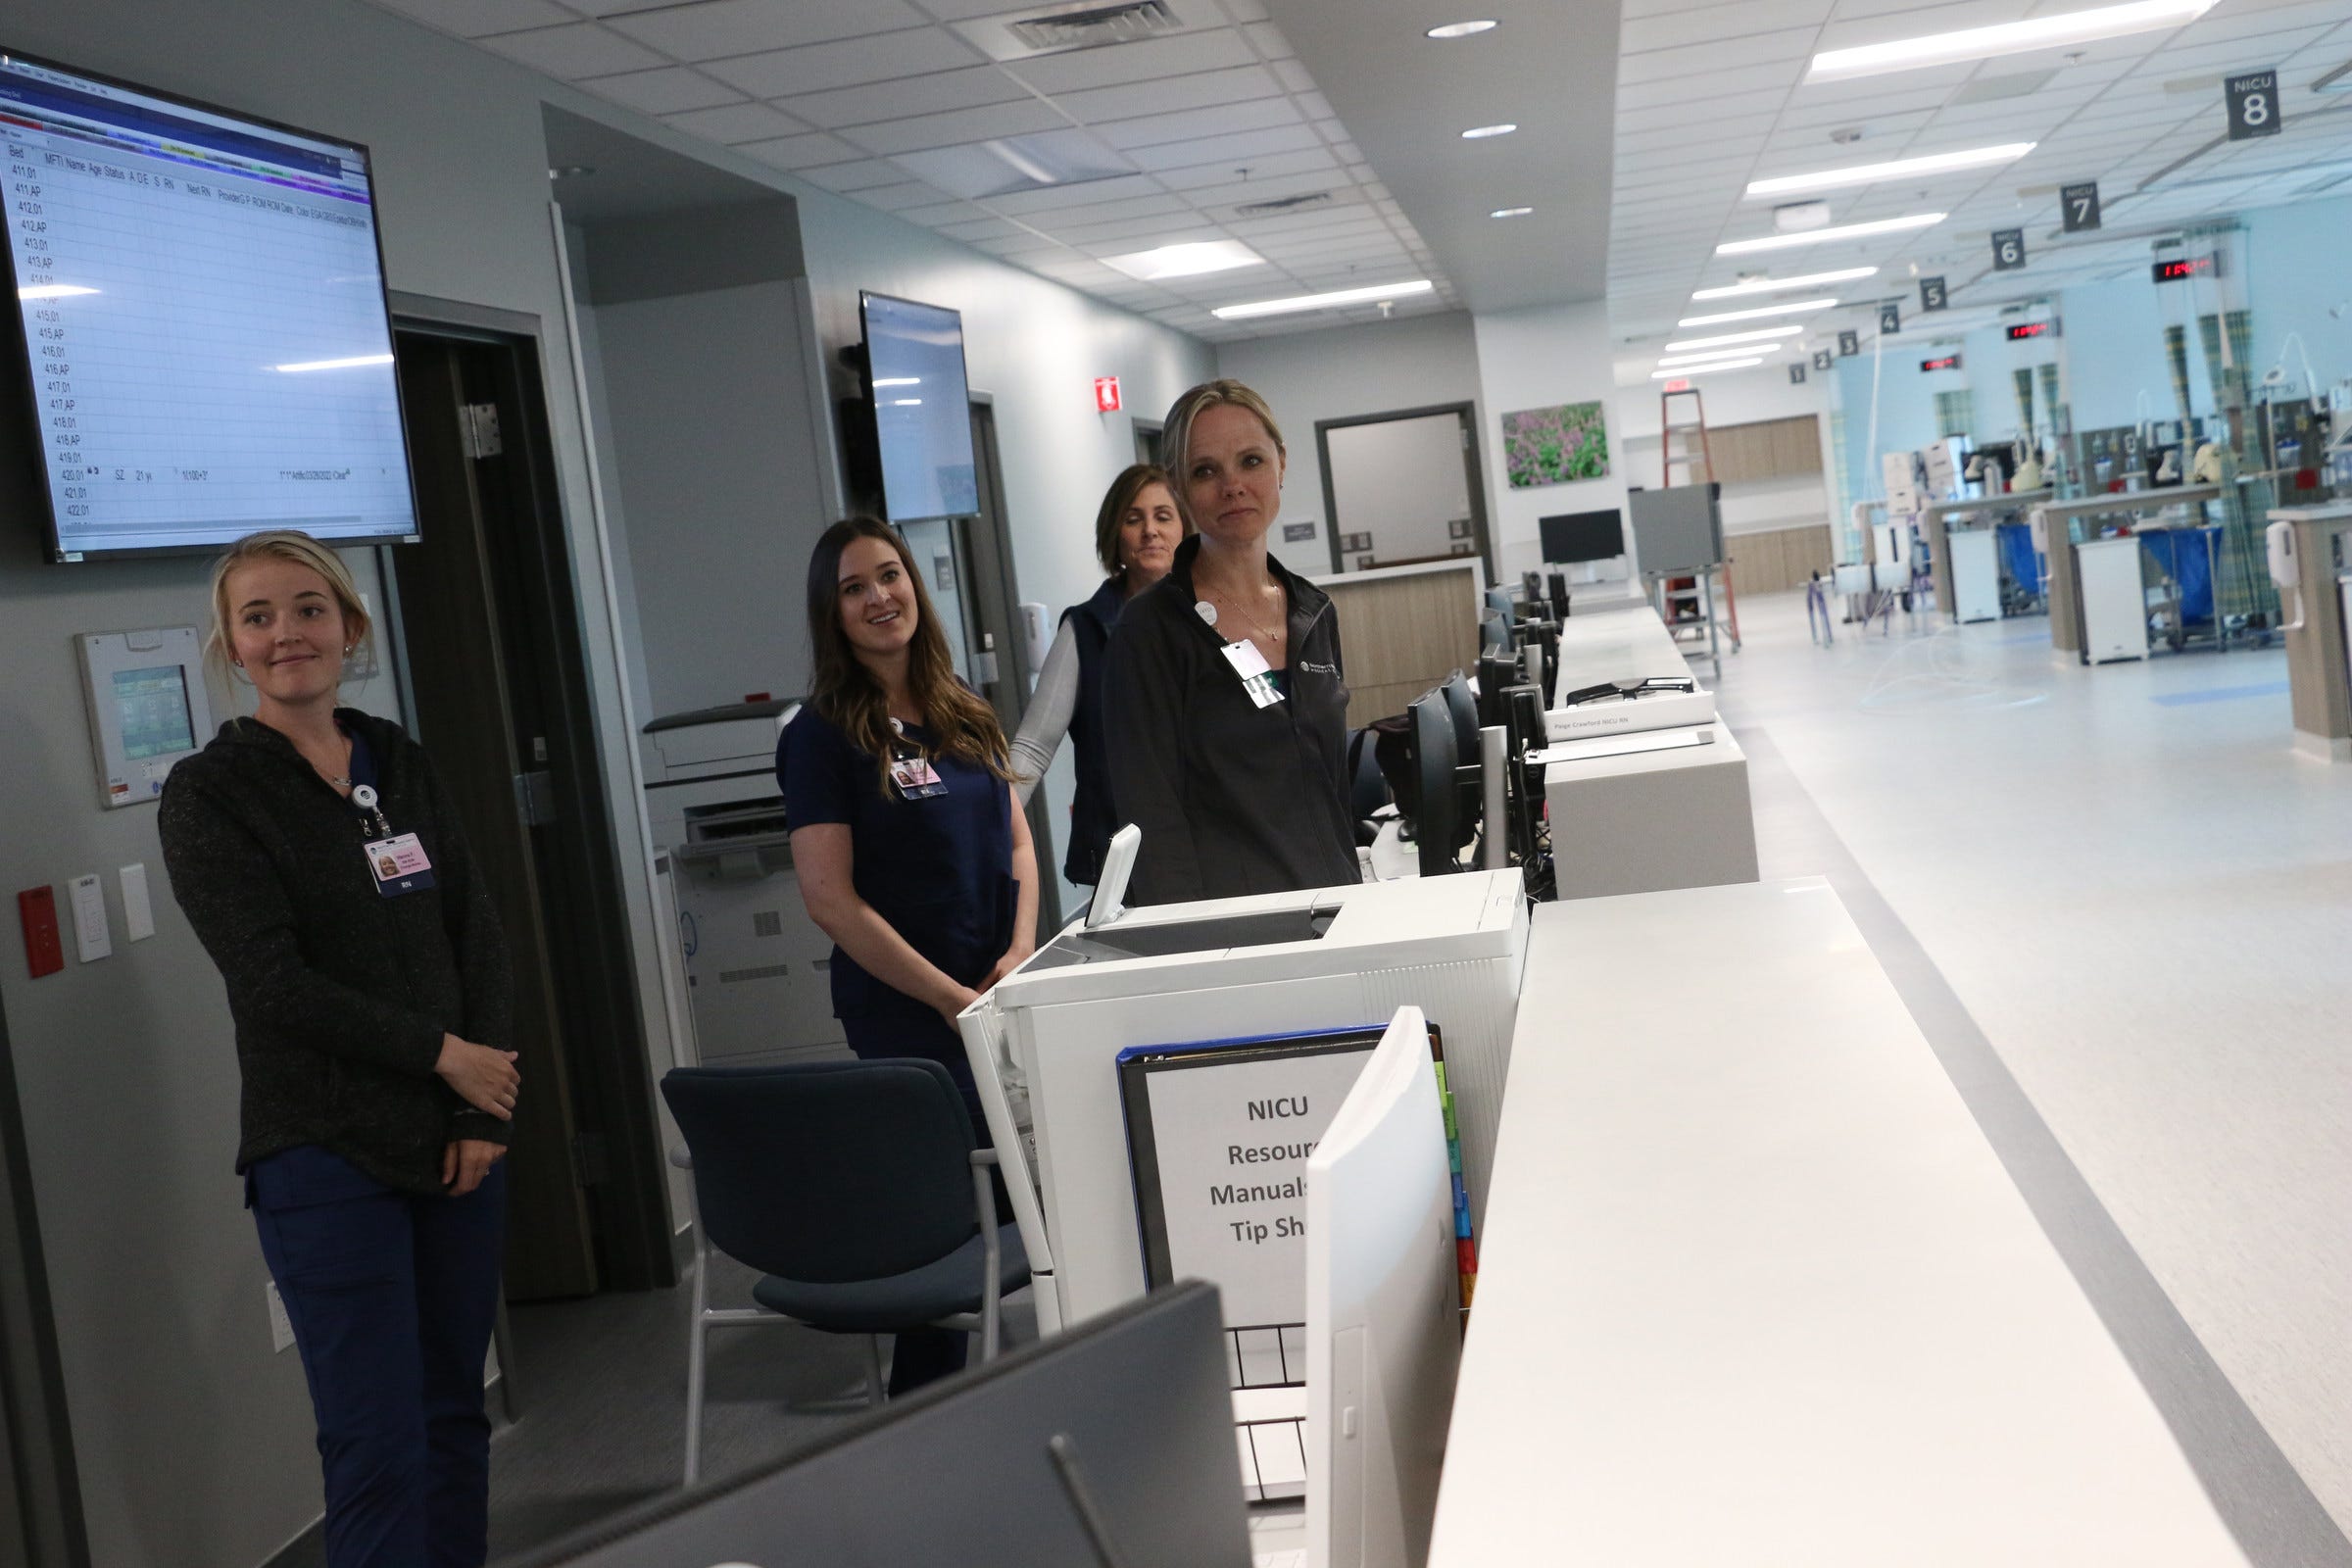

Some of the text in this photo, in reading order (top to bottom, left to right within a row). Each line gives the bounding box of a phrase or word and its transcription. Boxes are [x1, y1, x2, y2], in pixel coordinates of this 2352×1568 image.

[2234, 76, 2272, 93] NICU
[2243, 93, 2269, 126] 8
[10, 145, 24, 159] Bed
[67, 158, 87, 173] Name
[89, 165, 102, 176] Age
[104, 166, 125, 180] Status
[2072, 197, 2090, 223] 7
[2001, 241, 2018, 265] 6
[1928, 287, 1939, 306] 5
[1883, 315, 1895, 330] 4
[1818, 354, 1828, 368] 2
[1572, 719, 1601, 728] Crawford
[1248, 1096, 1308, 1121] NICU
[1210, 1176, 1307, 1205] Manual
[1230, 1215, 1305, 1245] Tip Sh
